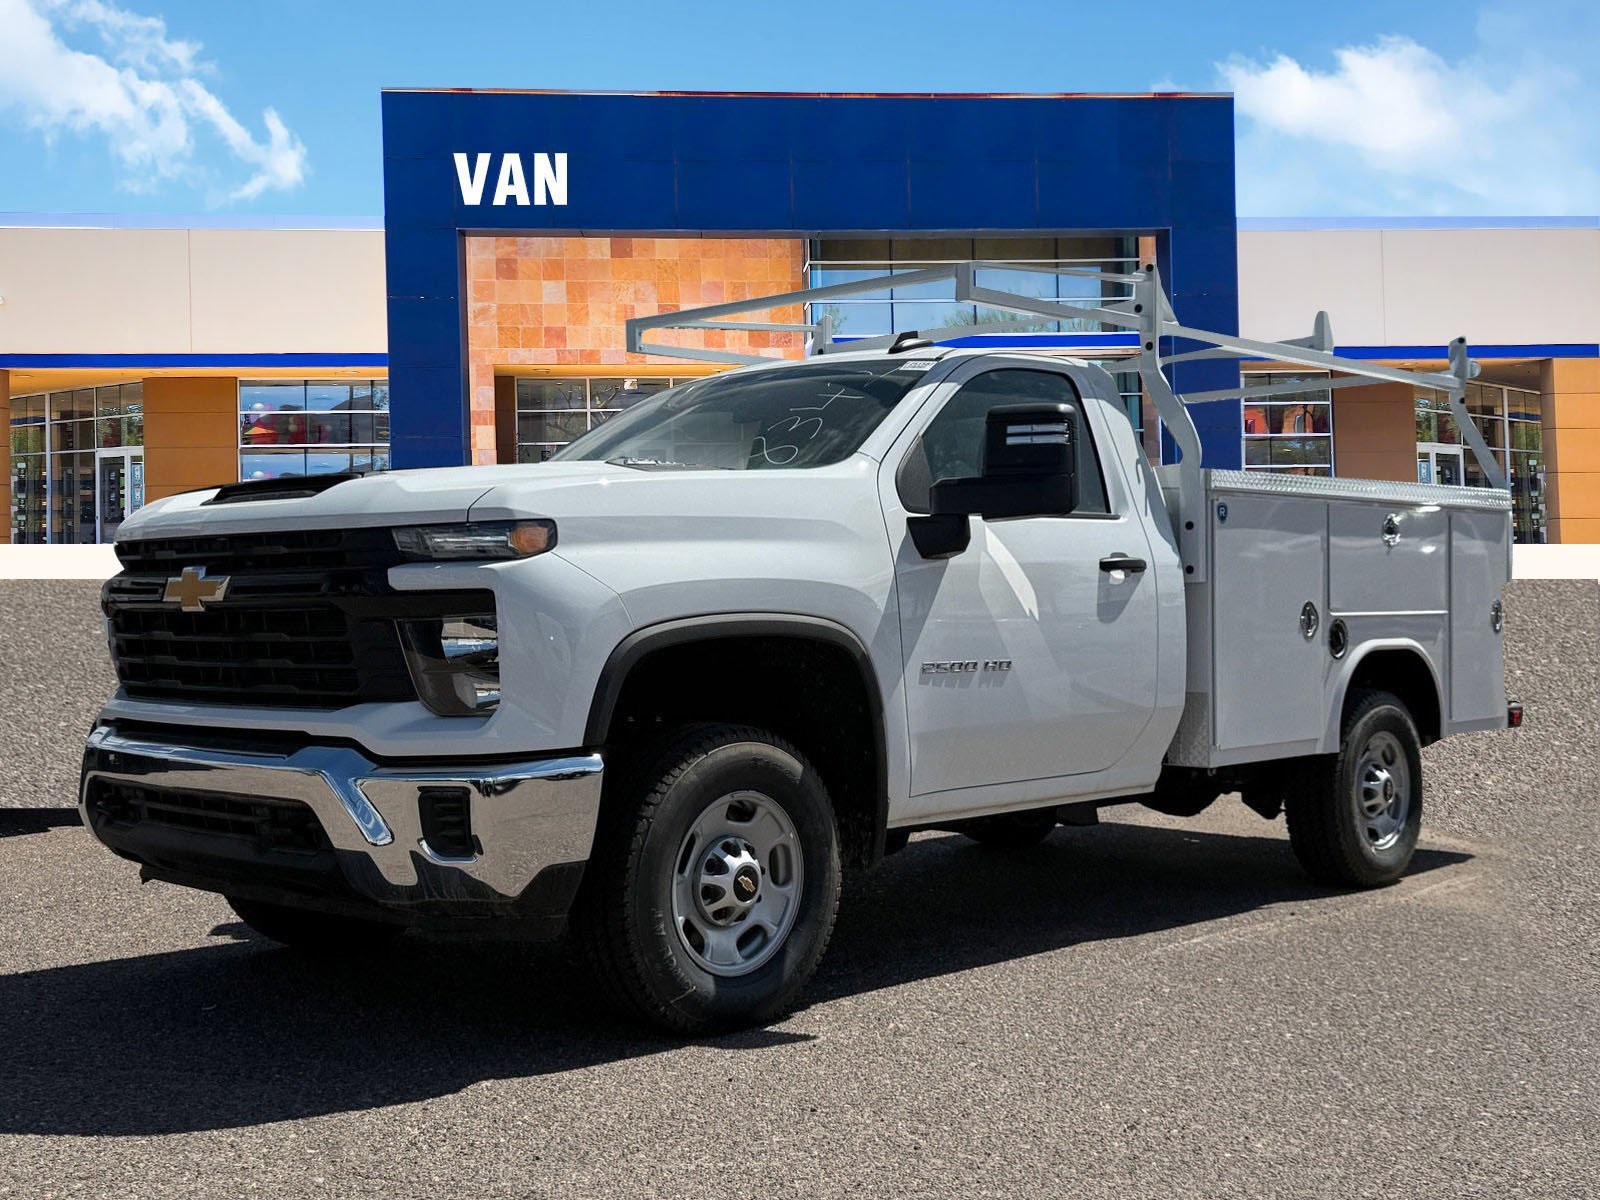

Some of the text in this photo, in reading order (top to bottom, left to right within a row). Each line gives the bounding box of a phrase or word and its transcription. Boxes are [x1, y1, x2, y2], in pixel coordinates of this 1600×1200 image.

[453, 152, 568, 206] VAN
[921, 659, 1012, 674] 2500 HD
